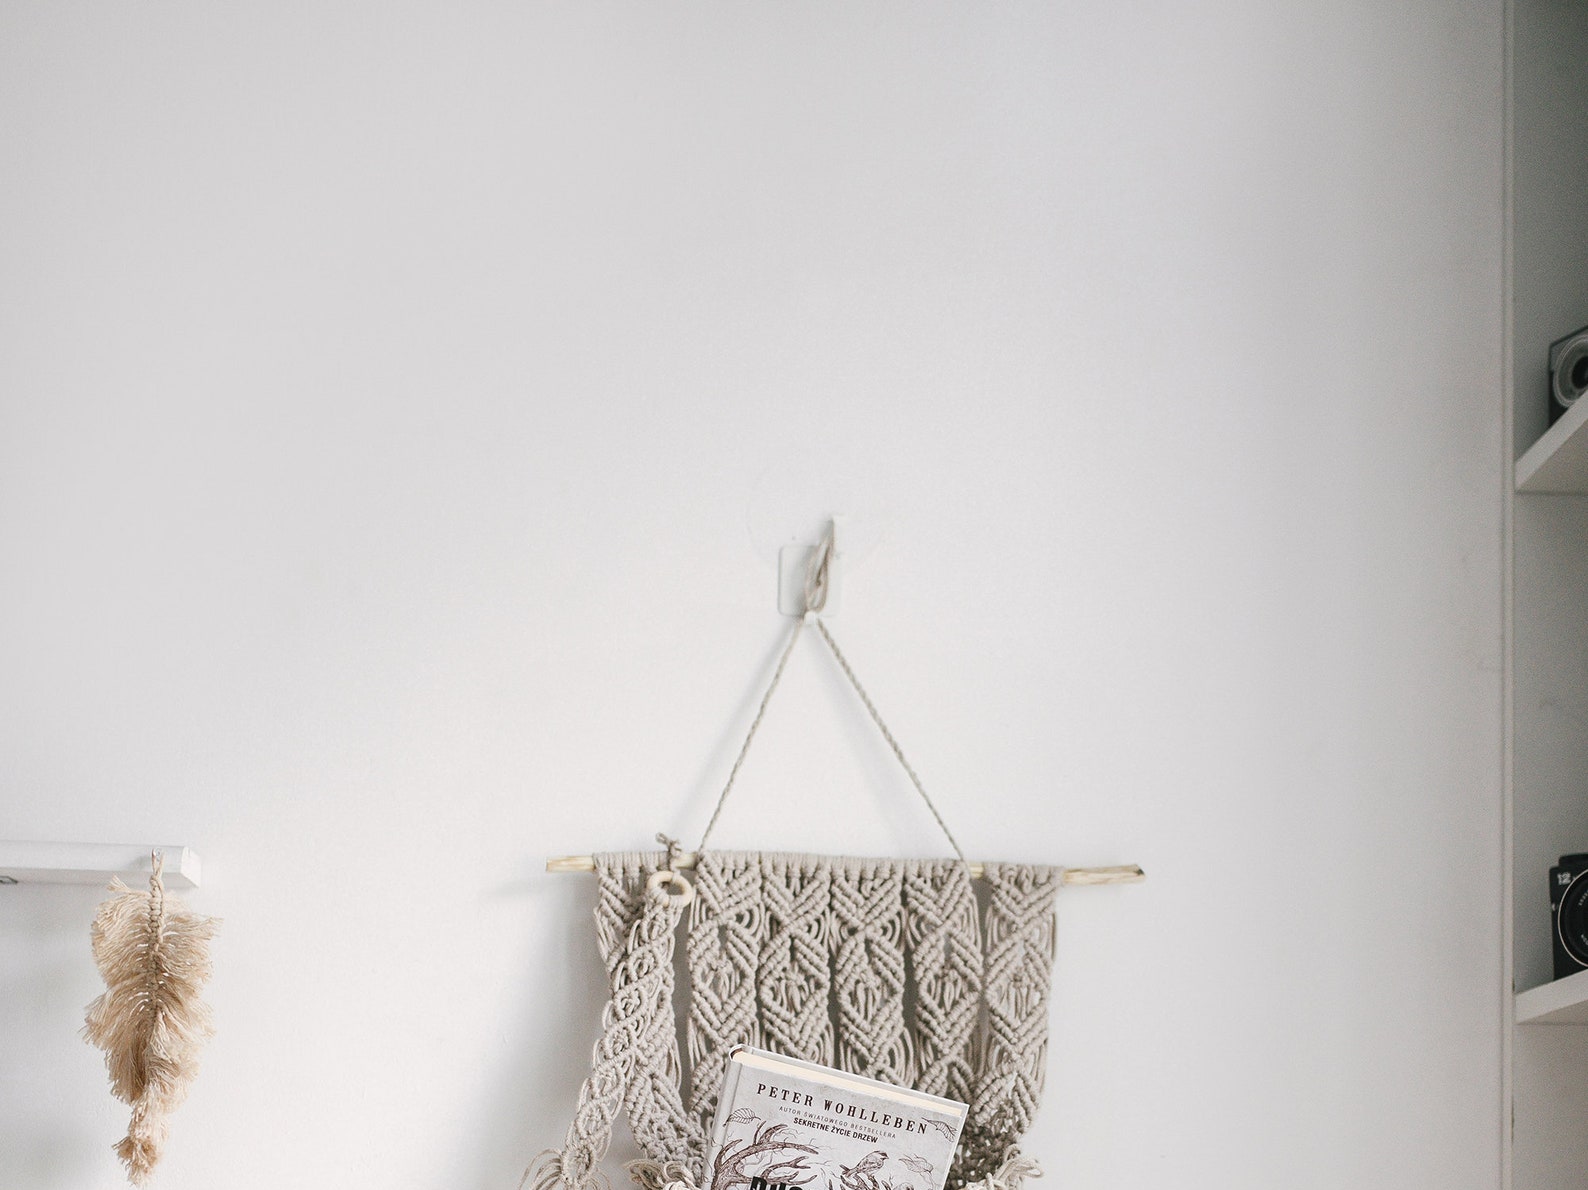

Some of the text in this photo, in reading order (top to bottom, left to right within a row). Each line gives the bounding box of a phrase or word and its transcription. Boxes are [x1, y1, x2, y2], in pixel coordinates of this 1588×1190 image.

[756, 1083, 929, 1135] PETER WOHLLEBEN
[778, 1106, 802, 1116] AUTOR
[850, 1122, 897, 1139] BESTSELLERA
[793, 1117, 879, 1144] SEKRETNE ŻYCIE DRZEW
